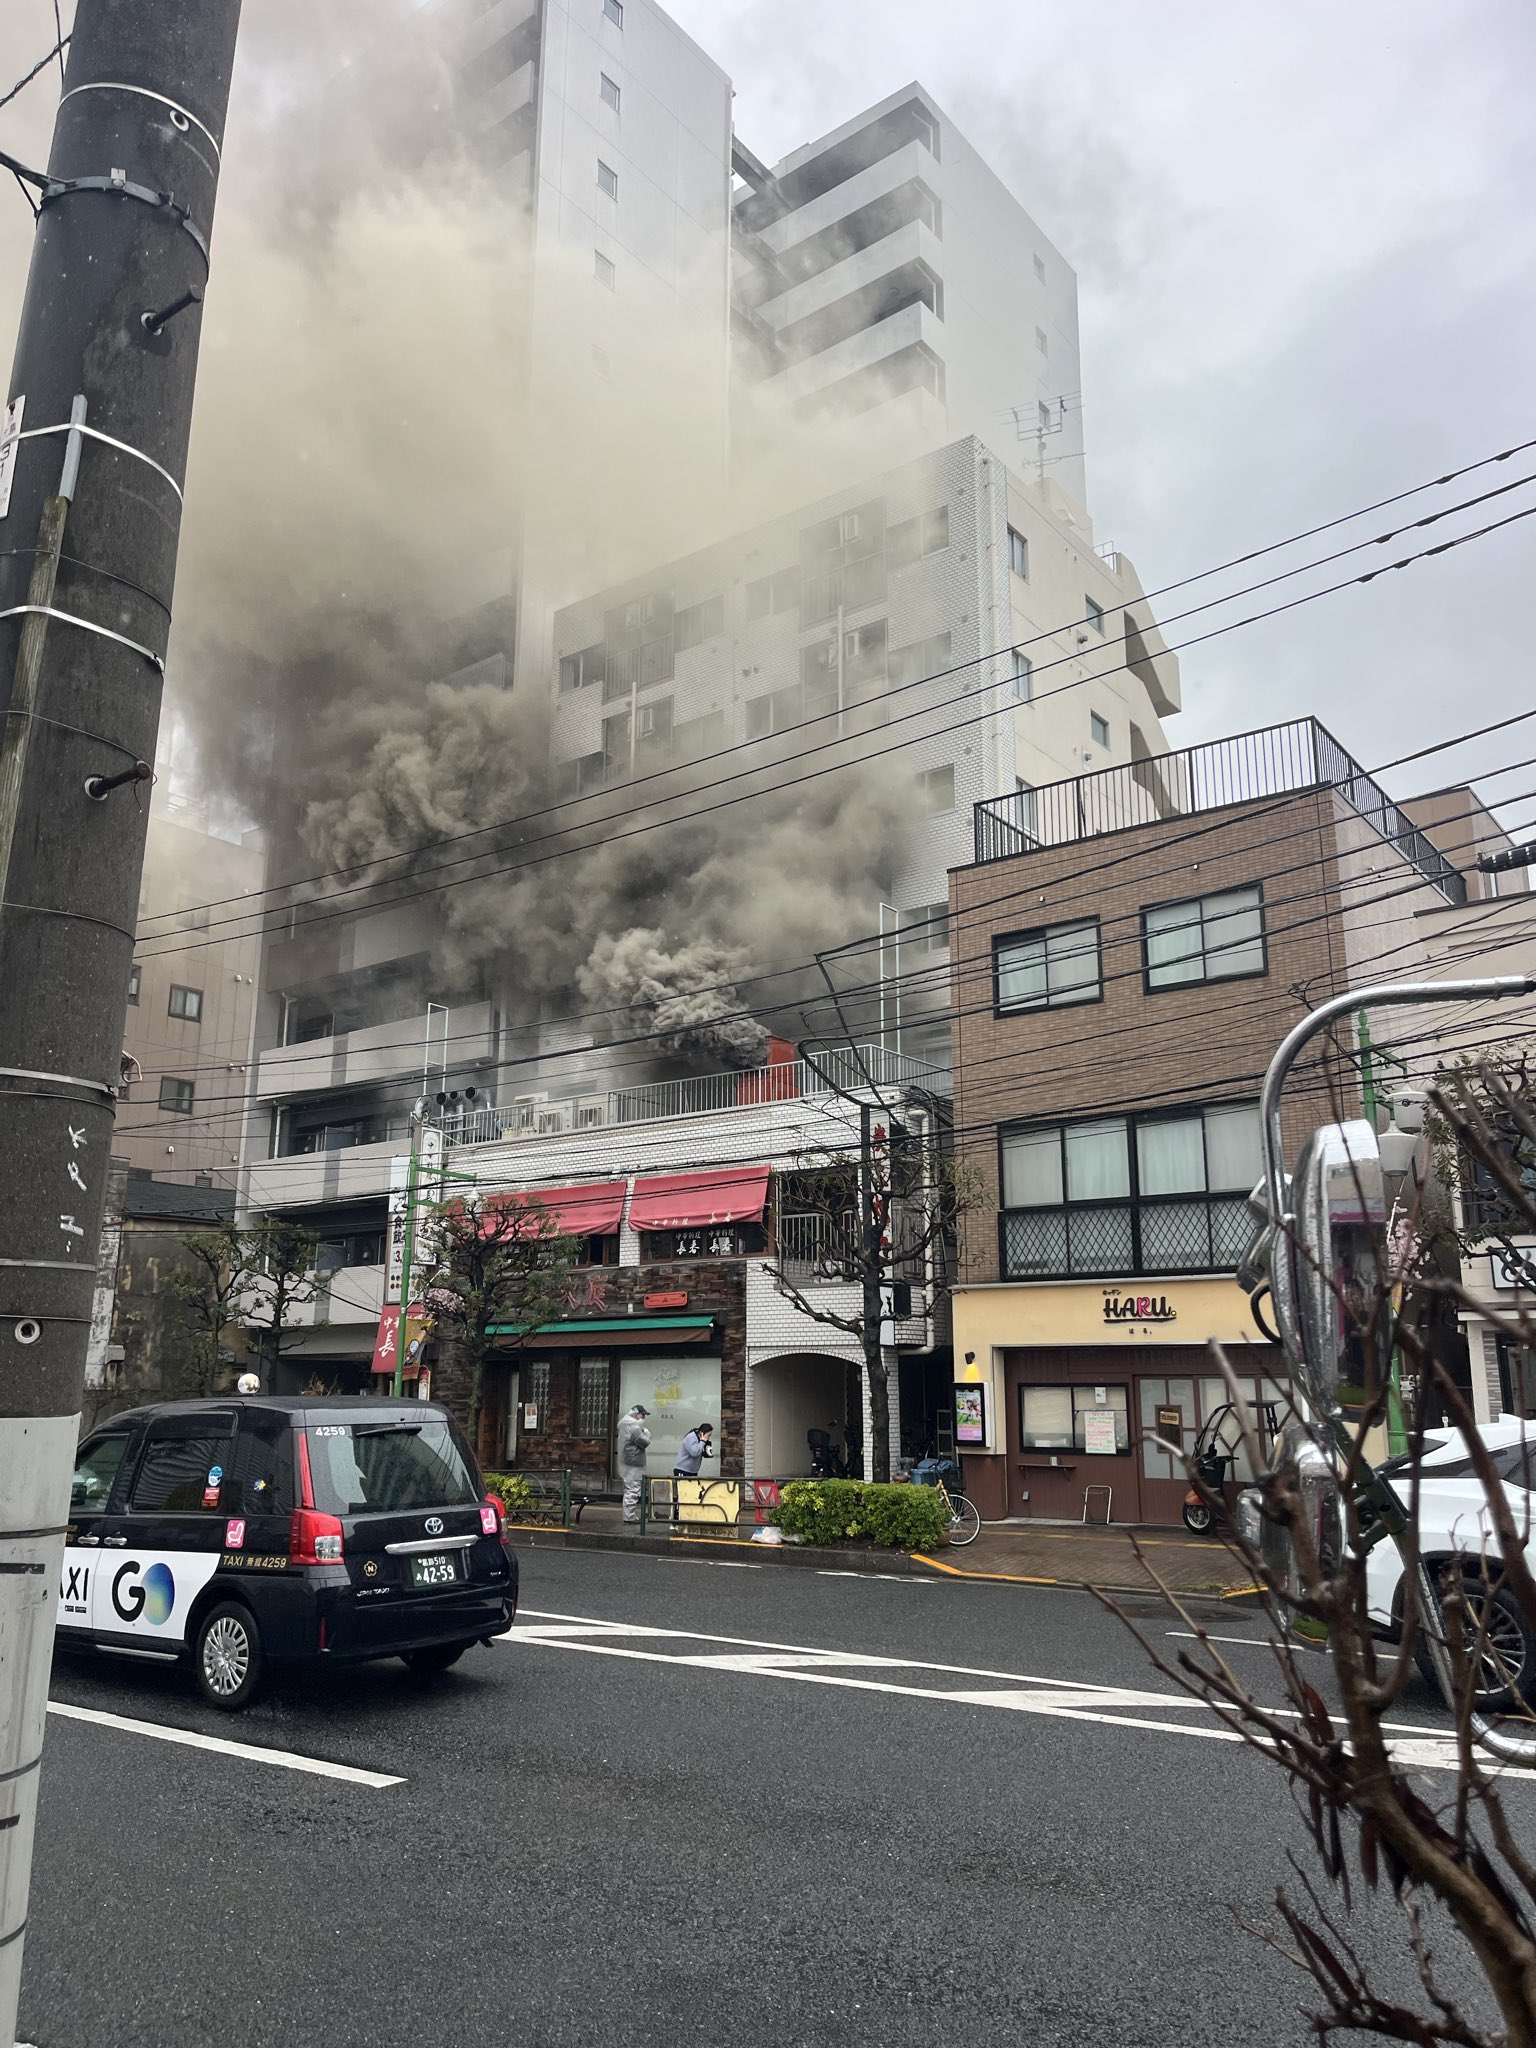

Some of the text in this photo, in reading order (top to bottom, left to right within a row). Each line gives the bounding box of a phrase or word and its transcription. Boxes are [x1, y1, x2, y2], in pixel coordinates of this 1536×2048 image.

[315, 1426, 346, 1436] 4259
[223, 1555, 244, 1567] TAXI
[434, 1556, 446, 1566] 510
[423, 1564, 455, 1583] 42-59
